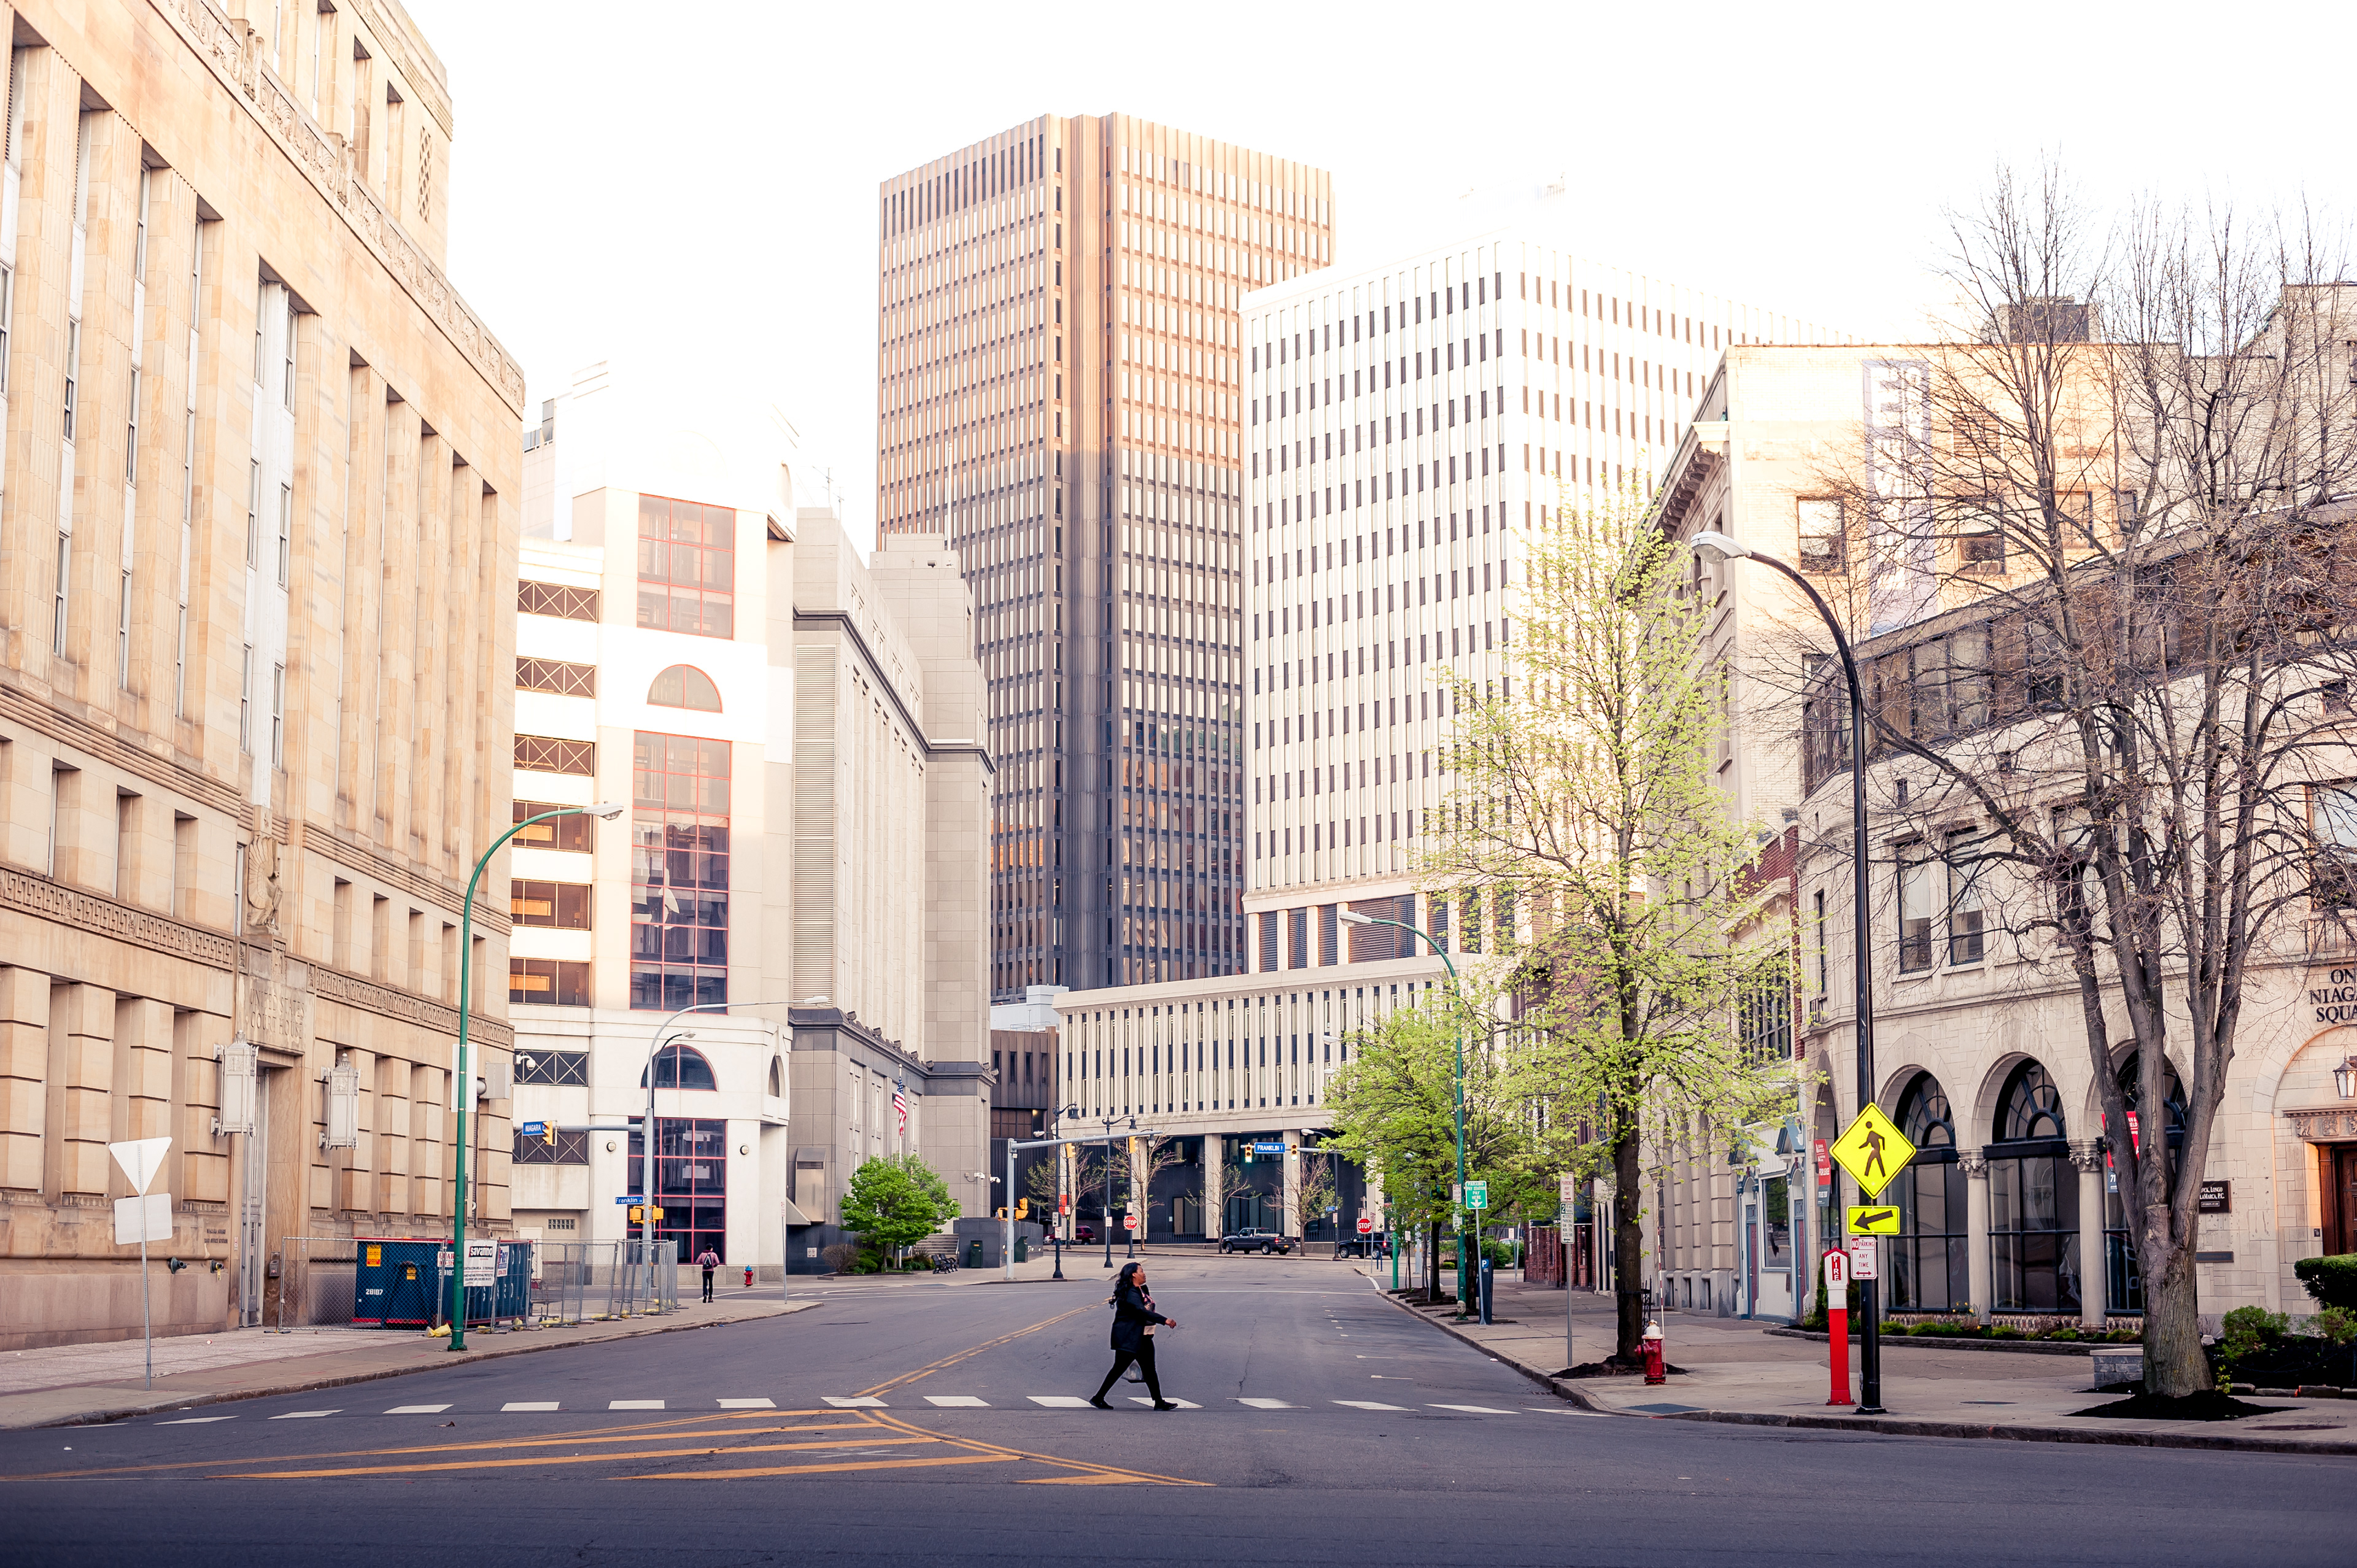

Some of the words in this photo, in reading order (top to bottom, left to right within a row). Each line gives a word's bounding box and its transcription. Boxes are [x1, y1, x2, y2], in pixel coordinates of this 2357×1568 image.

[250, 989, 278, 1011] UNITED
[281, 997, 304, 1019] STATES
[2309, 986, 2357, 1005] NIAG
[250, 1011, 276, 1033] COURT
[279, 1018, 303, 1040] HOUSE
[525, 1124, 541, 1132] NIAGARA
